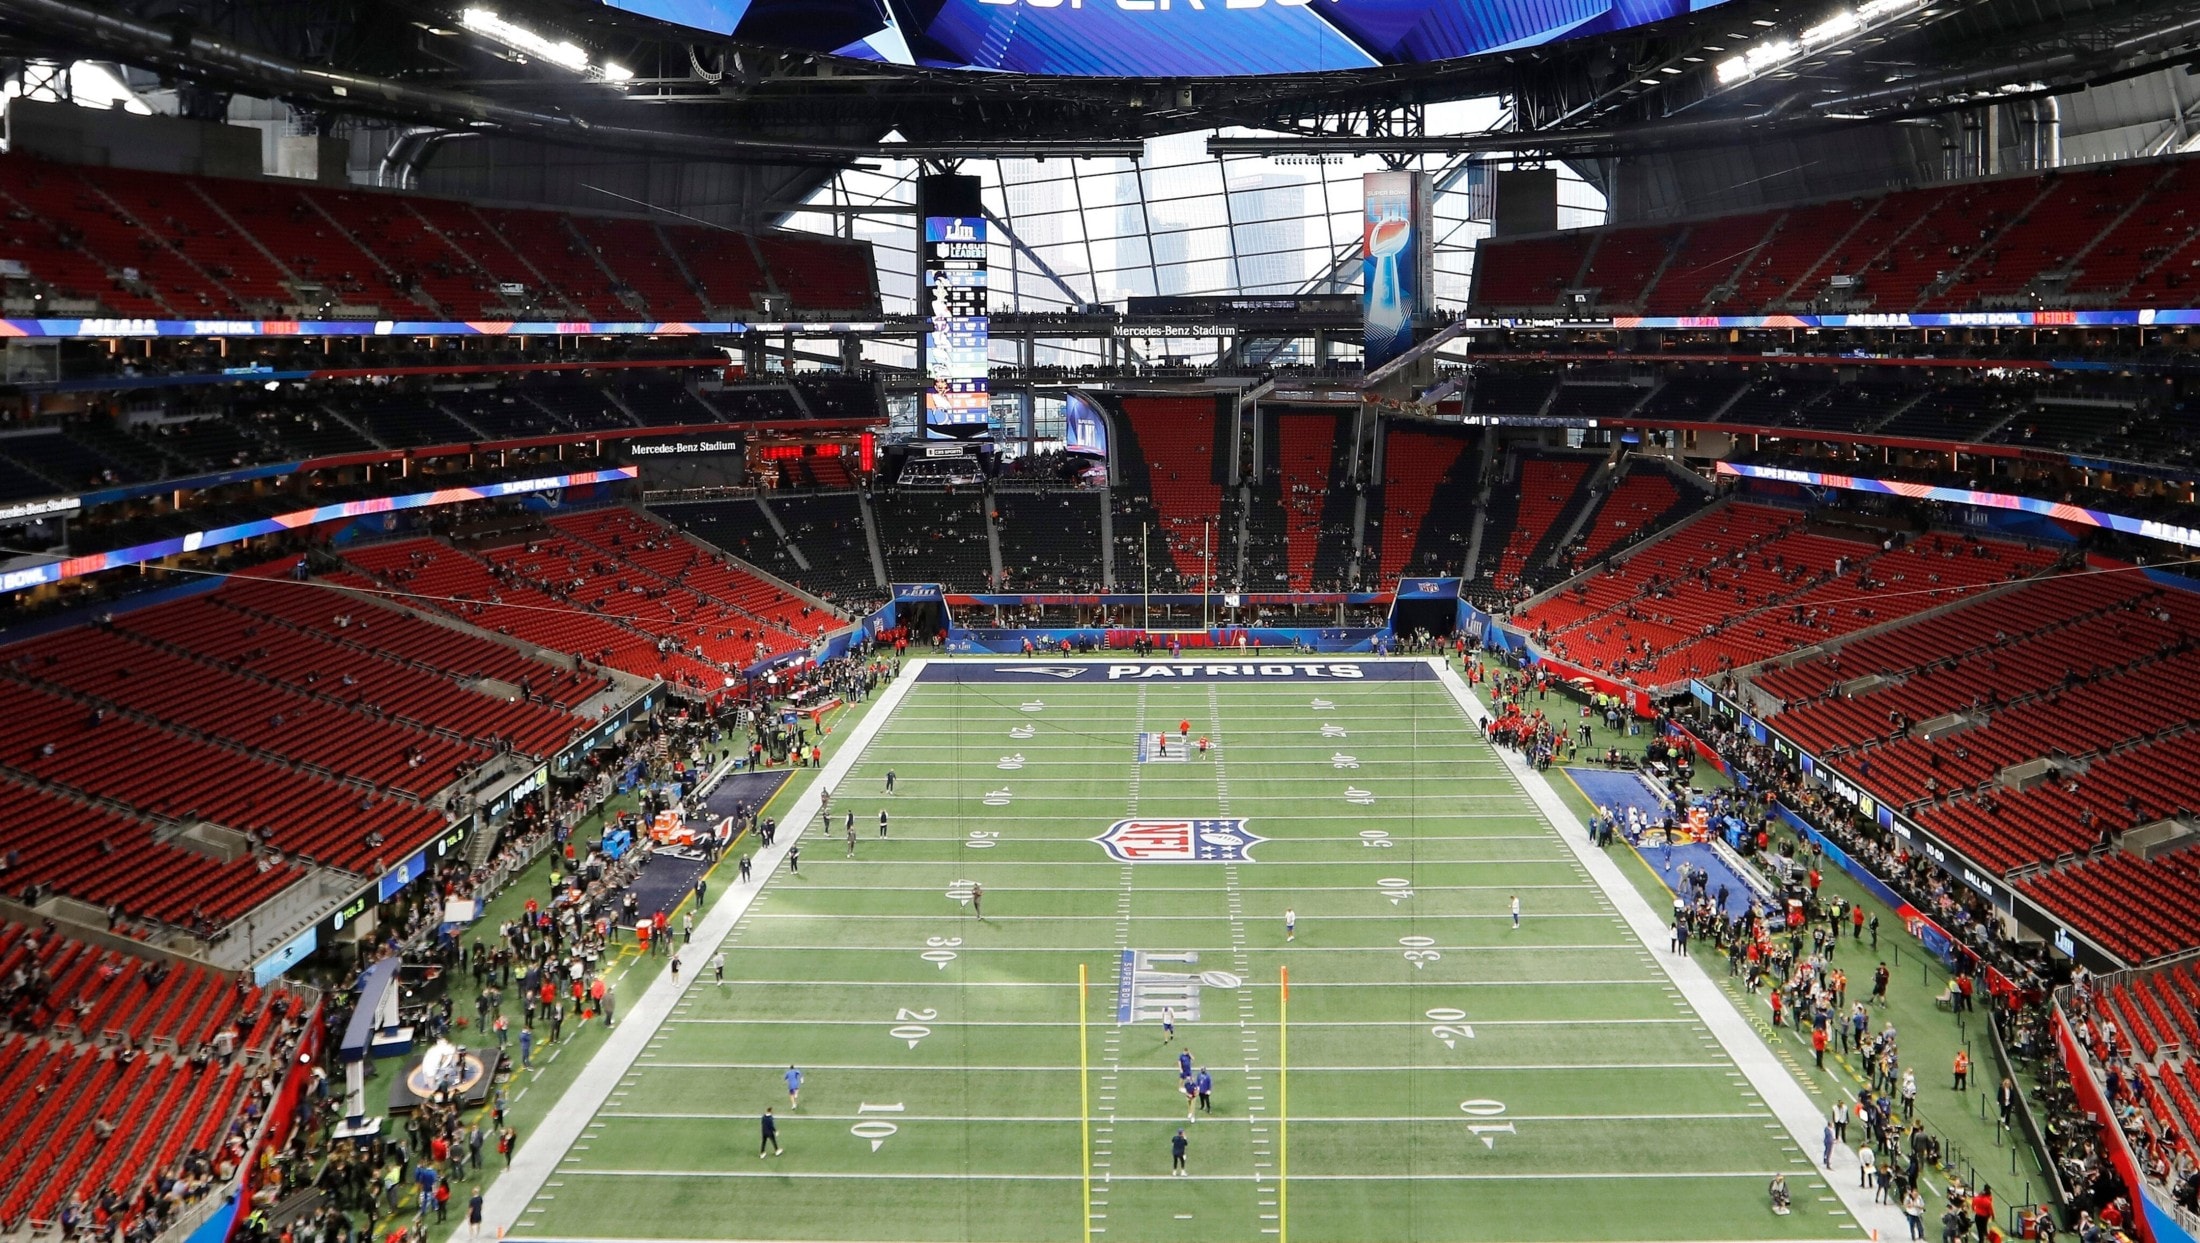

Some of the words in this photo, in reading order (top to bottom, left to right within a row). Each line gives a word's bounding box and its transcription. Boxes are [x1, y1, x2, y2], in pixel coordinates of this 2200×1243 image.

[951, 249, 986, 258] LEADERS
[1950, 313, 1986, 325] SUPER
[1988, 313, 2021, 325] BOWL
[1113, 325, 1190, 337] Mercedes-Benz
[1192, 325, 1236, 336] Stadium
[631, 443, 699, 455] Mercedes-Benz
[700, 441, 736, 451] Stadium
[1755, 466, 1786, 481] SUPER
[1786, 469, 1811, 483] BOWL
[503, 480, 534, 494] SUPER
[535, 477, 560, 490] BOWL
[47, 498, 81, 512] Stadium
[4, 567, 48, 590] BOWL
[1107, 664, 1364, 680] PATRIOTS
[1775, 738, 1780, 751] 0
[1835, 778, 1858, 805] 90:00
[1861, 795, 1873, 816] 40
[965, 830, 1000, 848] 50
[1116, 823, 1189, 858] NFL
[1359, 830, 1394, 848] 50
[1894, 821, 1911, 840] DOWN
[438, 839, 447, 856] 0
[1926, 842, 1935, 856] TO
[1935, 848, 1945, 863] GO
[1377, 878, 1415, 899] 40
[1964, 868, 1982, 889] BALL
[1981, 881, 1993, 896] ON
[334, 911, 344, 931] 0
[356, 898, 365, 913] 3
[921, 936, 963, 962] 30
[1399, 936, 1441, 962] 30
[1122, 962, 1133, 987] SUPER
[1120, 988, 1131, 1009] BOWL
[890, 1008, 938, 1039] 20
[1425, 1007, 1476, 1039] 20
[851, 1102, 906, 1139] 10
[1460, 1099, 1517, 1136] 10
